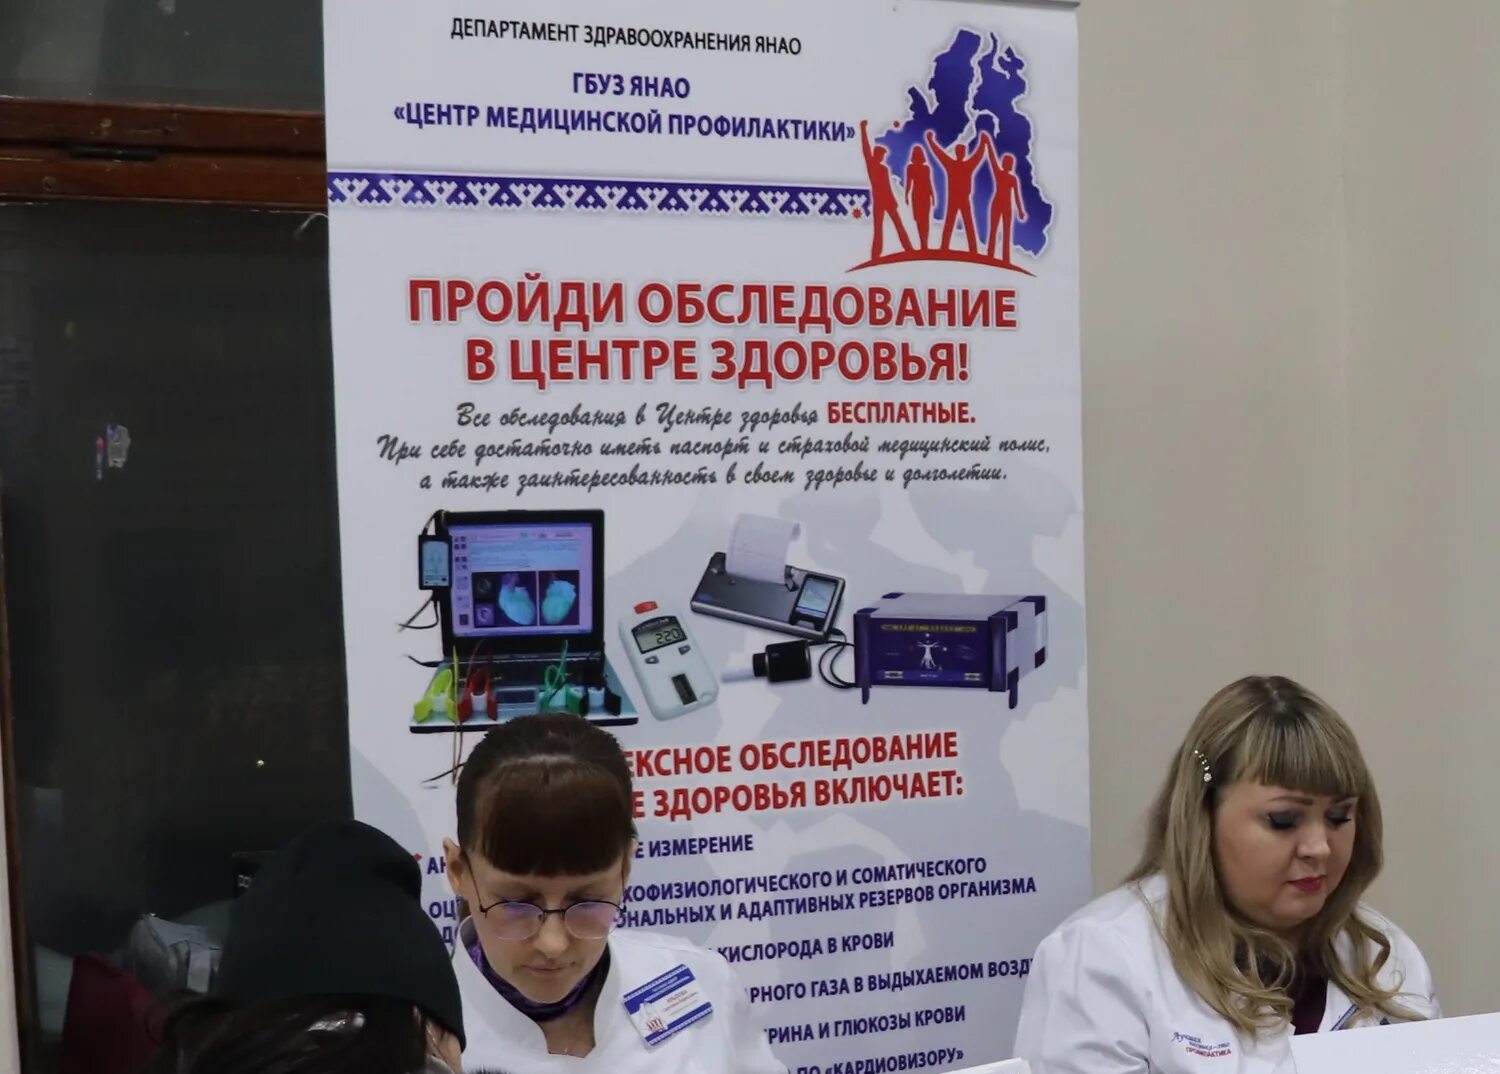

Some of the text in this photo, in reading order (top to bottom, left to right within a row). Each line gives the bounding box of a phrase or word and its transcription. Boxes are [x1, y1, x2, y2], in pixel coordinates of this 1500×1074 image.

[451, 17, 802, 55] ДЕПАРТАМЕНТ ЗДРАВООХРАНЕНИЯ ЯНАО
[573, 72, 691, 99] ГБУЗ ЯНАО
[394, 102, 856, 142] «ЦЕНТР МЕДИЦИНСКОЙ ПРОФИЛАКТИКИ»
[408, 271, 1018, 335] ПРОЙДИ ОБСЛЕДОВАНИЕ
[465, 339, 970, 391] В ЦЕНТРЕ ЗДОРОВЬЯ!
[456, 401, 977, 434] Все обследования в Центре здоровья БЕСПЛАТНЫЕ.
[376, 432, 1051, 467] При себе достаточно иметь паспорт и страховой медицинский полис,
[419, 461, 1008, 497] а также заинтересованность в своем здоровье и долголетии.
[738, 731, 959, 772] ОБСЛЕДОВАНИЕ
[652, 779, 807, 822] ЗДОРОВЬЯ
[813, 768, 965, 807] ВКЛЮЧАЕТ:
[648, 833, 755, 860] ИЗМЕРЕНИЕ
[835, 869, 849, 887] И
[851, 856, 988, 886] СОМАТИЧЕСКОГО
[719, 902, 734, 921] И
[736, 892, 856, 923] АДАПТИВНЫХ
[858, 884, 935, 910] РЕЗЕРВОВ
[937, 875, 1038, 901] ОРГАНИЗМА
[826, 937, 838, 954] В
[841, 930, 895, 953] КРОВИ
[747, 957, 1035, 1004] РНОГО ГАЗА В ВЫДЫХАЕМОМ ВОЗД
[764, 1004, 967, 1046] РИНА И ГЛЮКОЗЫ КРОВИ
